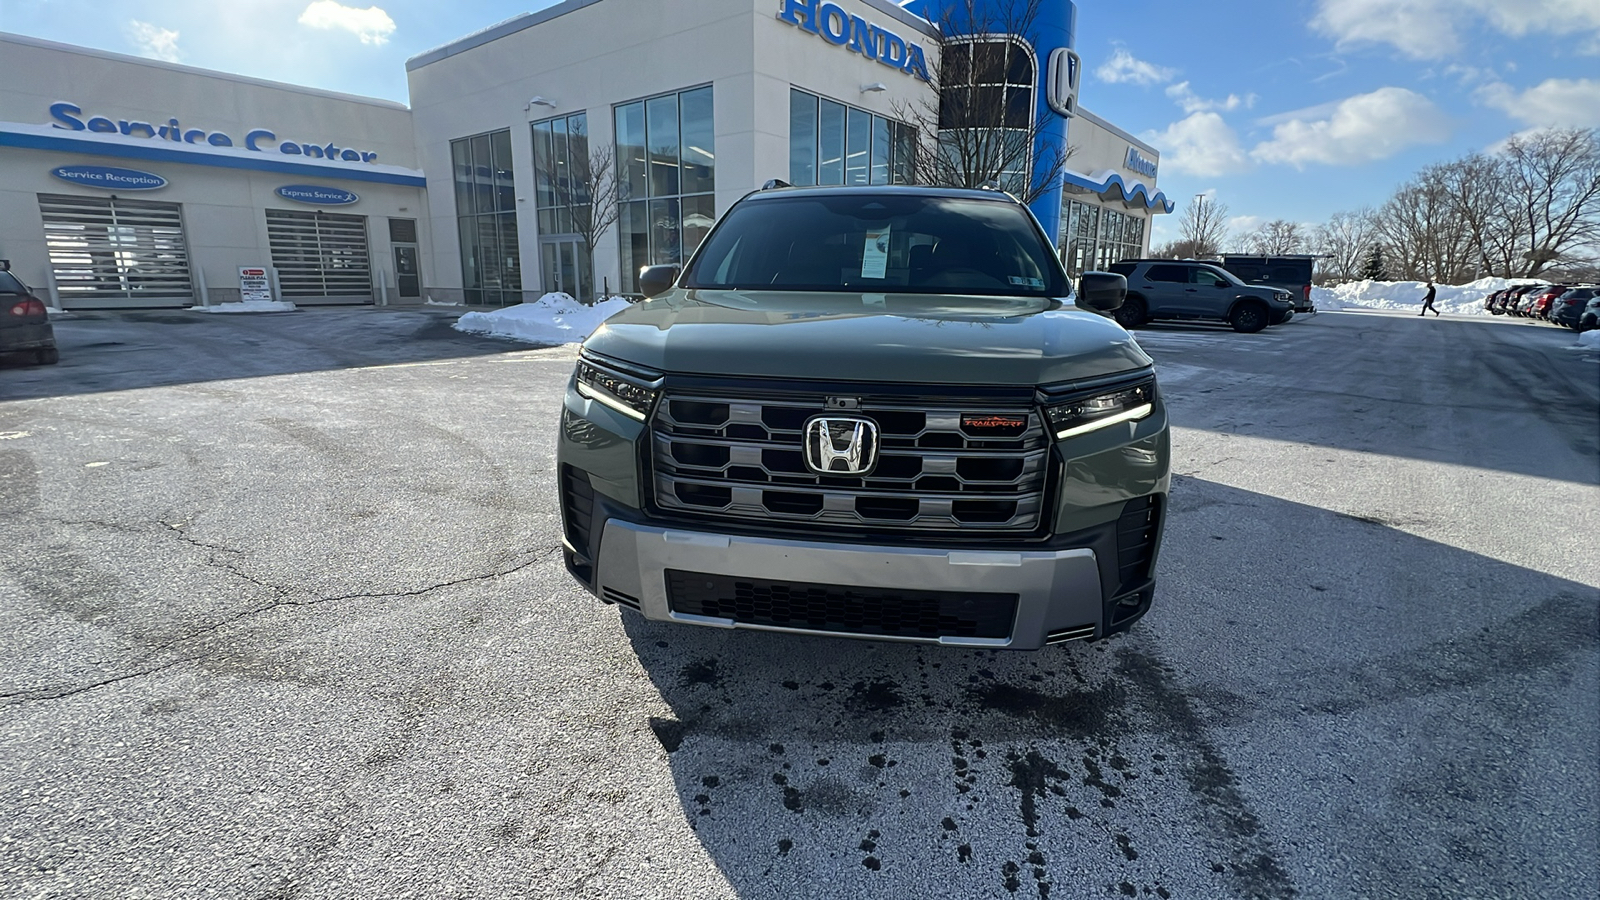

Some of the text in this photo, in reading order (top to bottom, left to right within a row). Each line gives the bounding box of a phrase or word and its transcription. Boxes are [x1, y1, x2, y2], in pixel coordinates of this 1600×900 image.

[777, 0, 931, 82] HONDA
[49, 102, 377, 163] Service Center
[59, 169, 160, 185] Service Reception
[281, 188, 343, 200] Express Service
[964, 419, 1024, 428] TRAILSPORT
